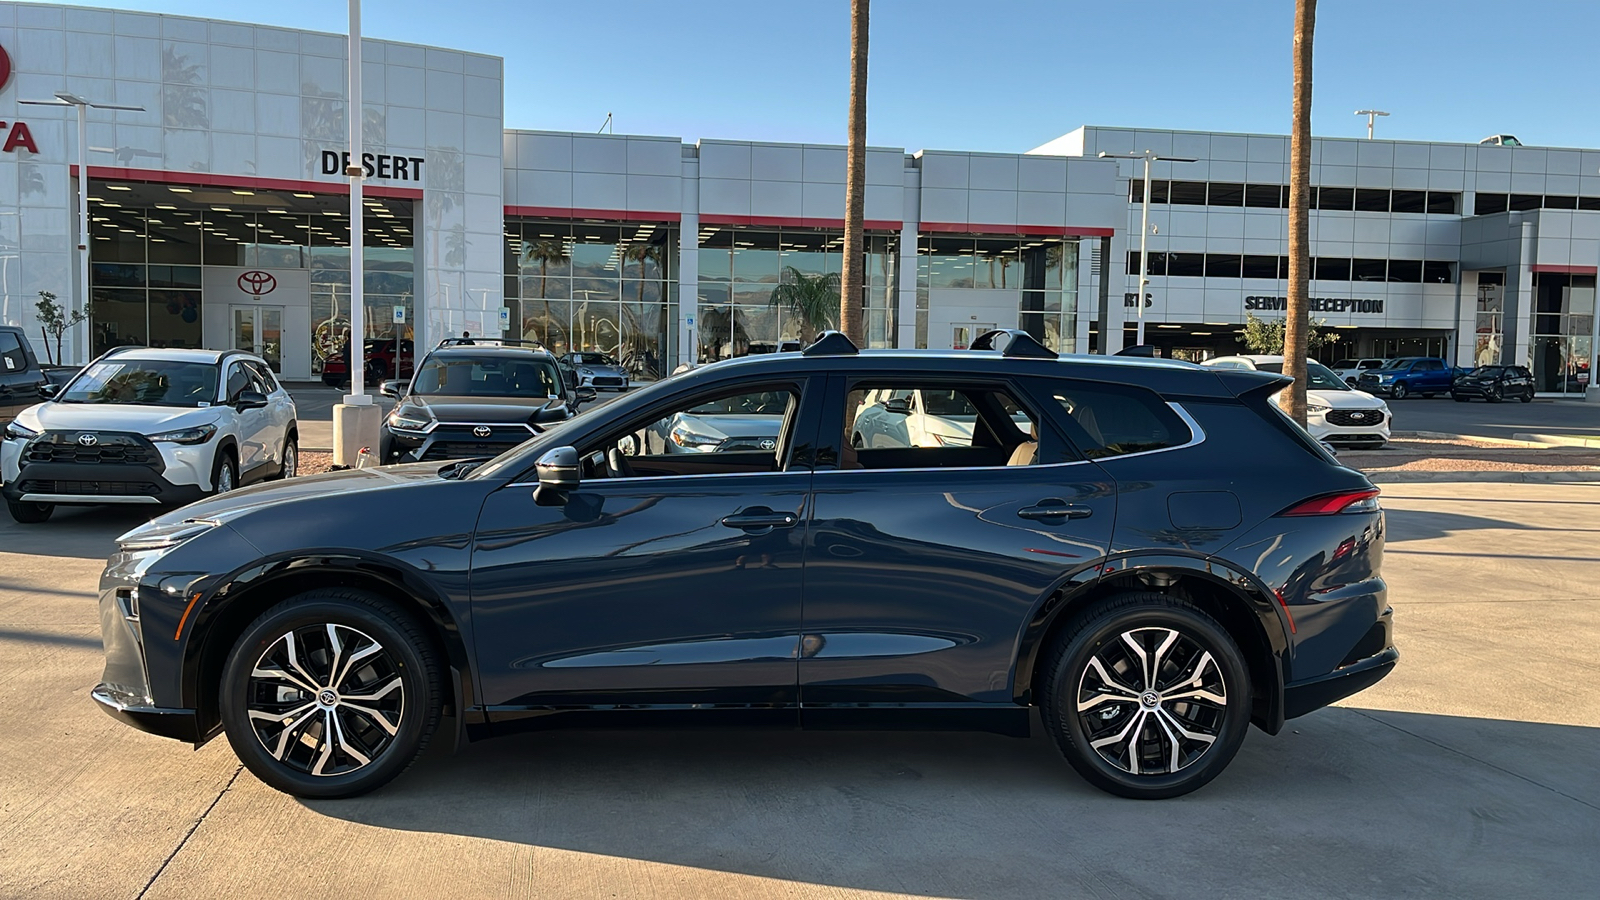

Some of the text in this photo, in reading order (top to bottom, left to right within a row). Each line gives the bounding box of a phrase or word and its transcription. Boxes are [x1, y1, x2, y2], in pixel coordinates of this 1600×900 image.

[322, 150, 424, 181] DESERT
[1245, 296, 1383, 313] SERVI RECEPTION
